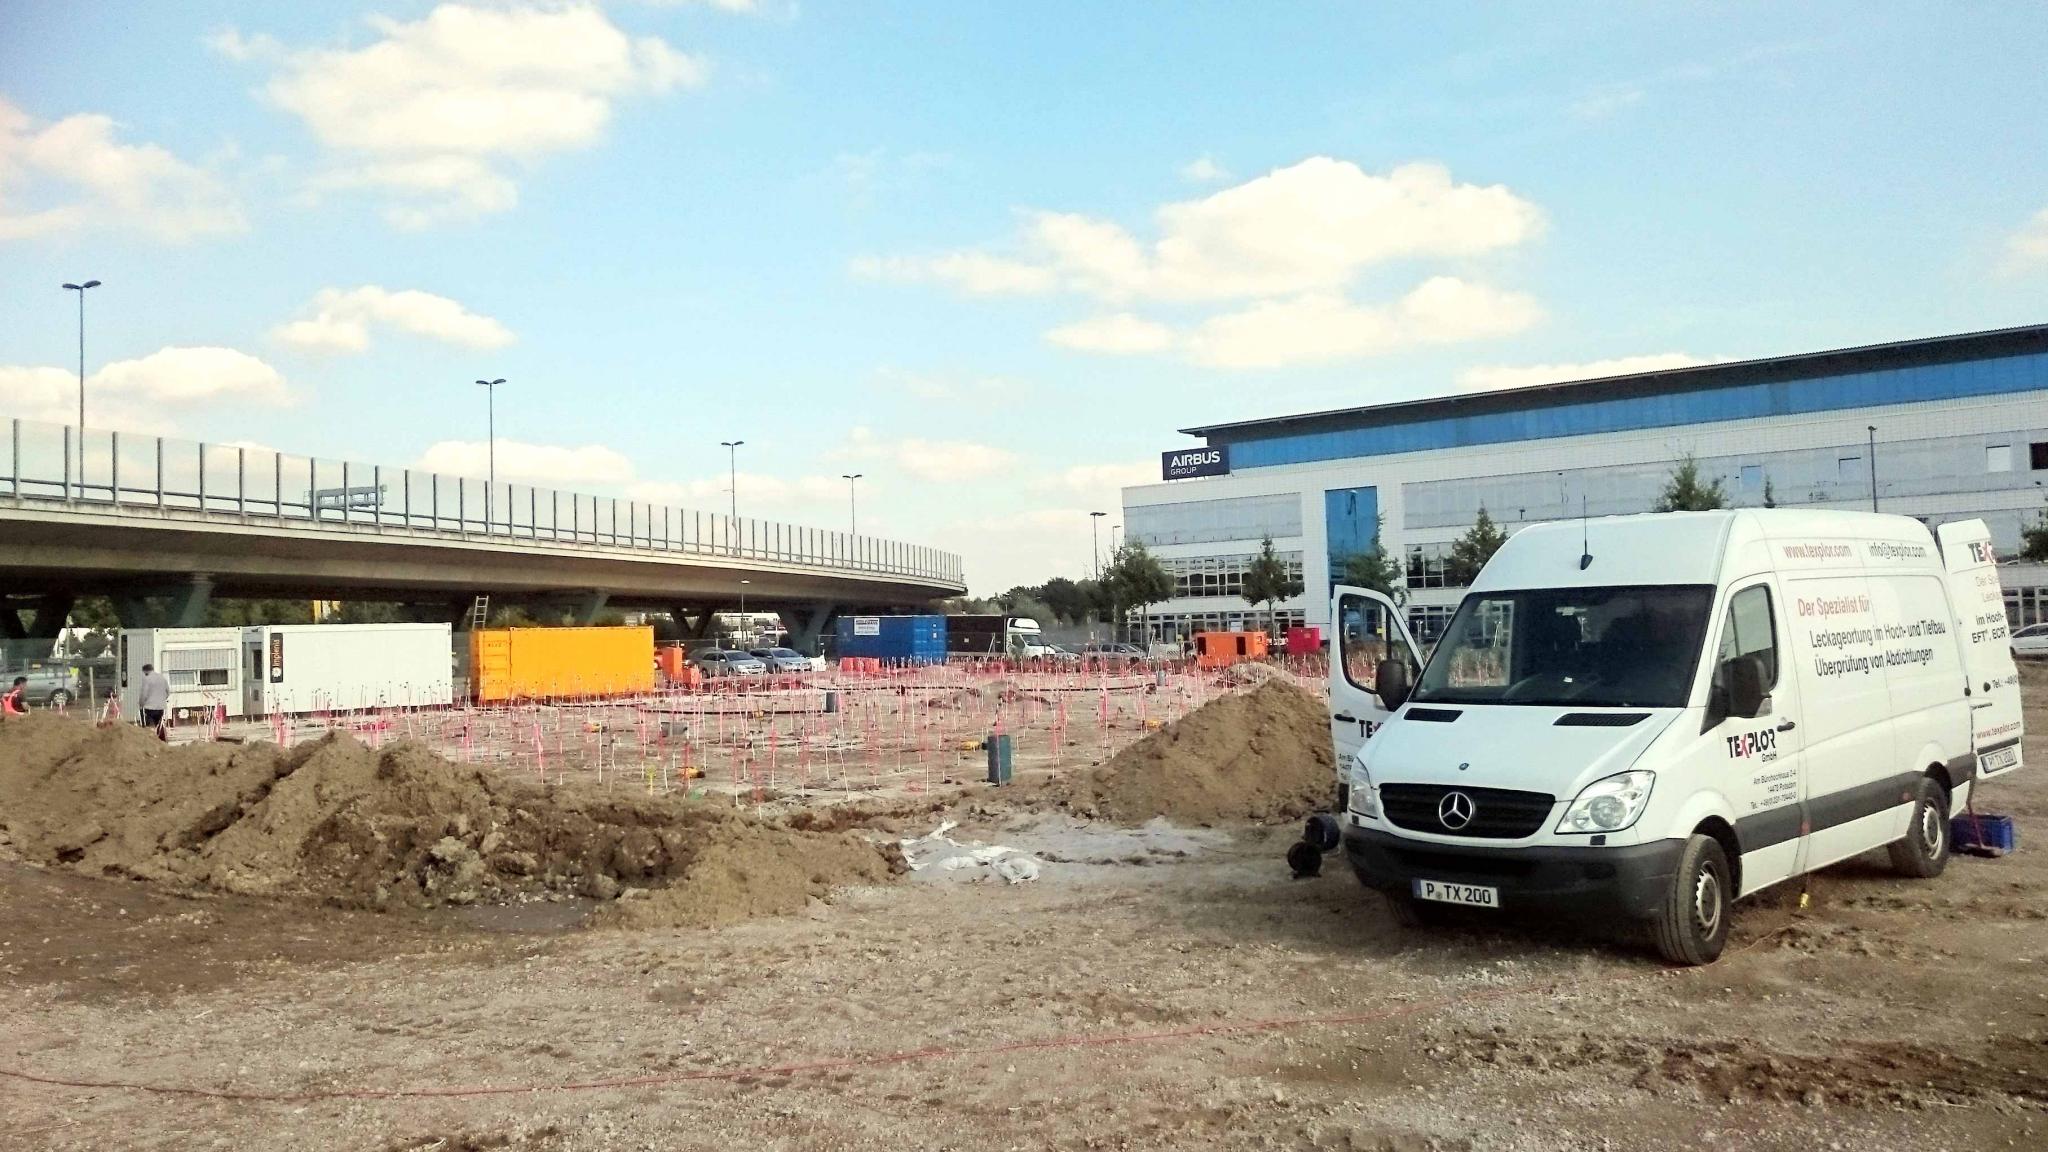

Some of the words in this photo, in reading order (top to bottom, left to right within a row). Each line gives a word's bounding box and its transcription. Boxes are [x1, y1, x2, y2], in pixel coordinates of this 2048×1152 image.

[1170, 451, 1220, 467] AIRBUS
[1170, 467, 1197, 475] GROUP
[1782, 542, 1853, 561] www.texplor.com
[1867, 542, 1927, 560] info@texplor.com
[1798, 598, 1815, 617] Der
[1817, 596, 1859, 620] Spezialist
[1859, 594, 1870, 612] für
[1809, 627, 1874, 650] Leckageortung
[1873, 624, 1884, 641] im
[1884, 622, 1906, 640] Hoch-
[1907, 620, 1921, 637] und
[1920, 618, 1946, 636] Tiefbau
[1815, 653, 1869, 679] Überprüfung
[1869, 654, 1885, 669] von
[1886, 648, 1934, 666] Abdichtungen
[1726, 728, 1776, 758] TEXPLOR
[1761, 750, 1777, 762] GmbH
[1425, 883, 1435, 897] P
[1443, 885, 1461, 901] TX
[1464, 887, 1492, 904] 200
